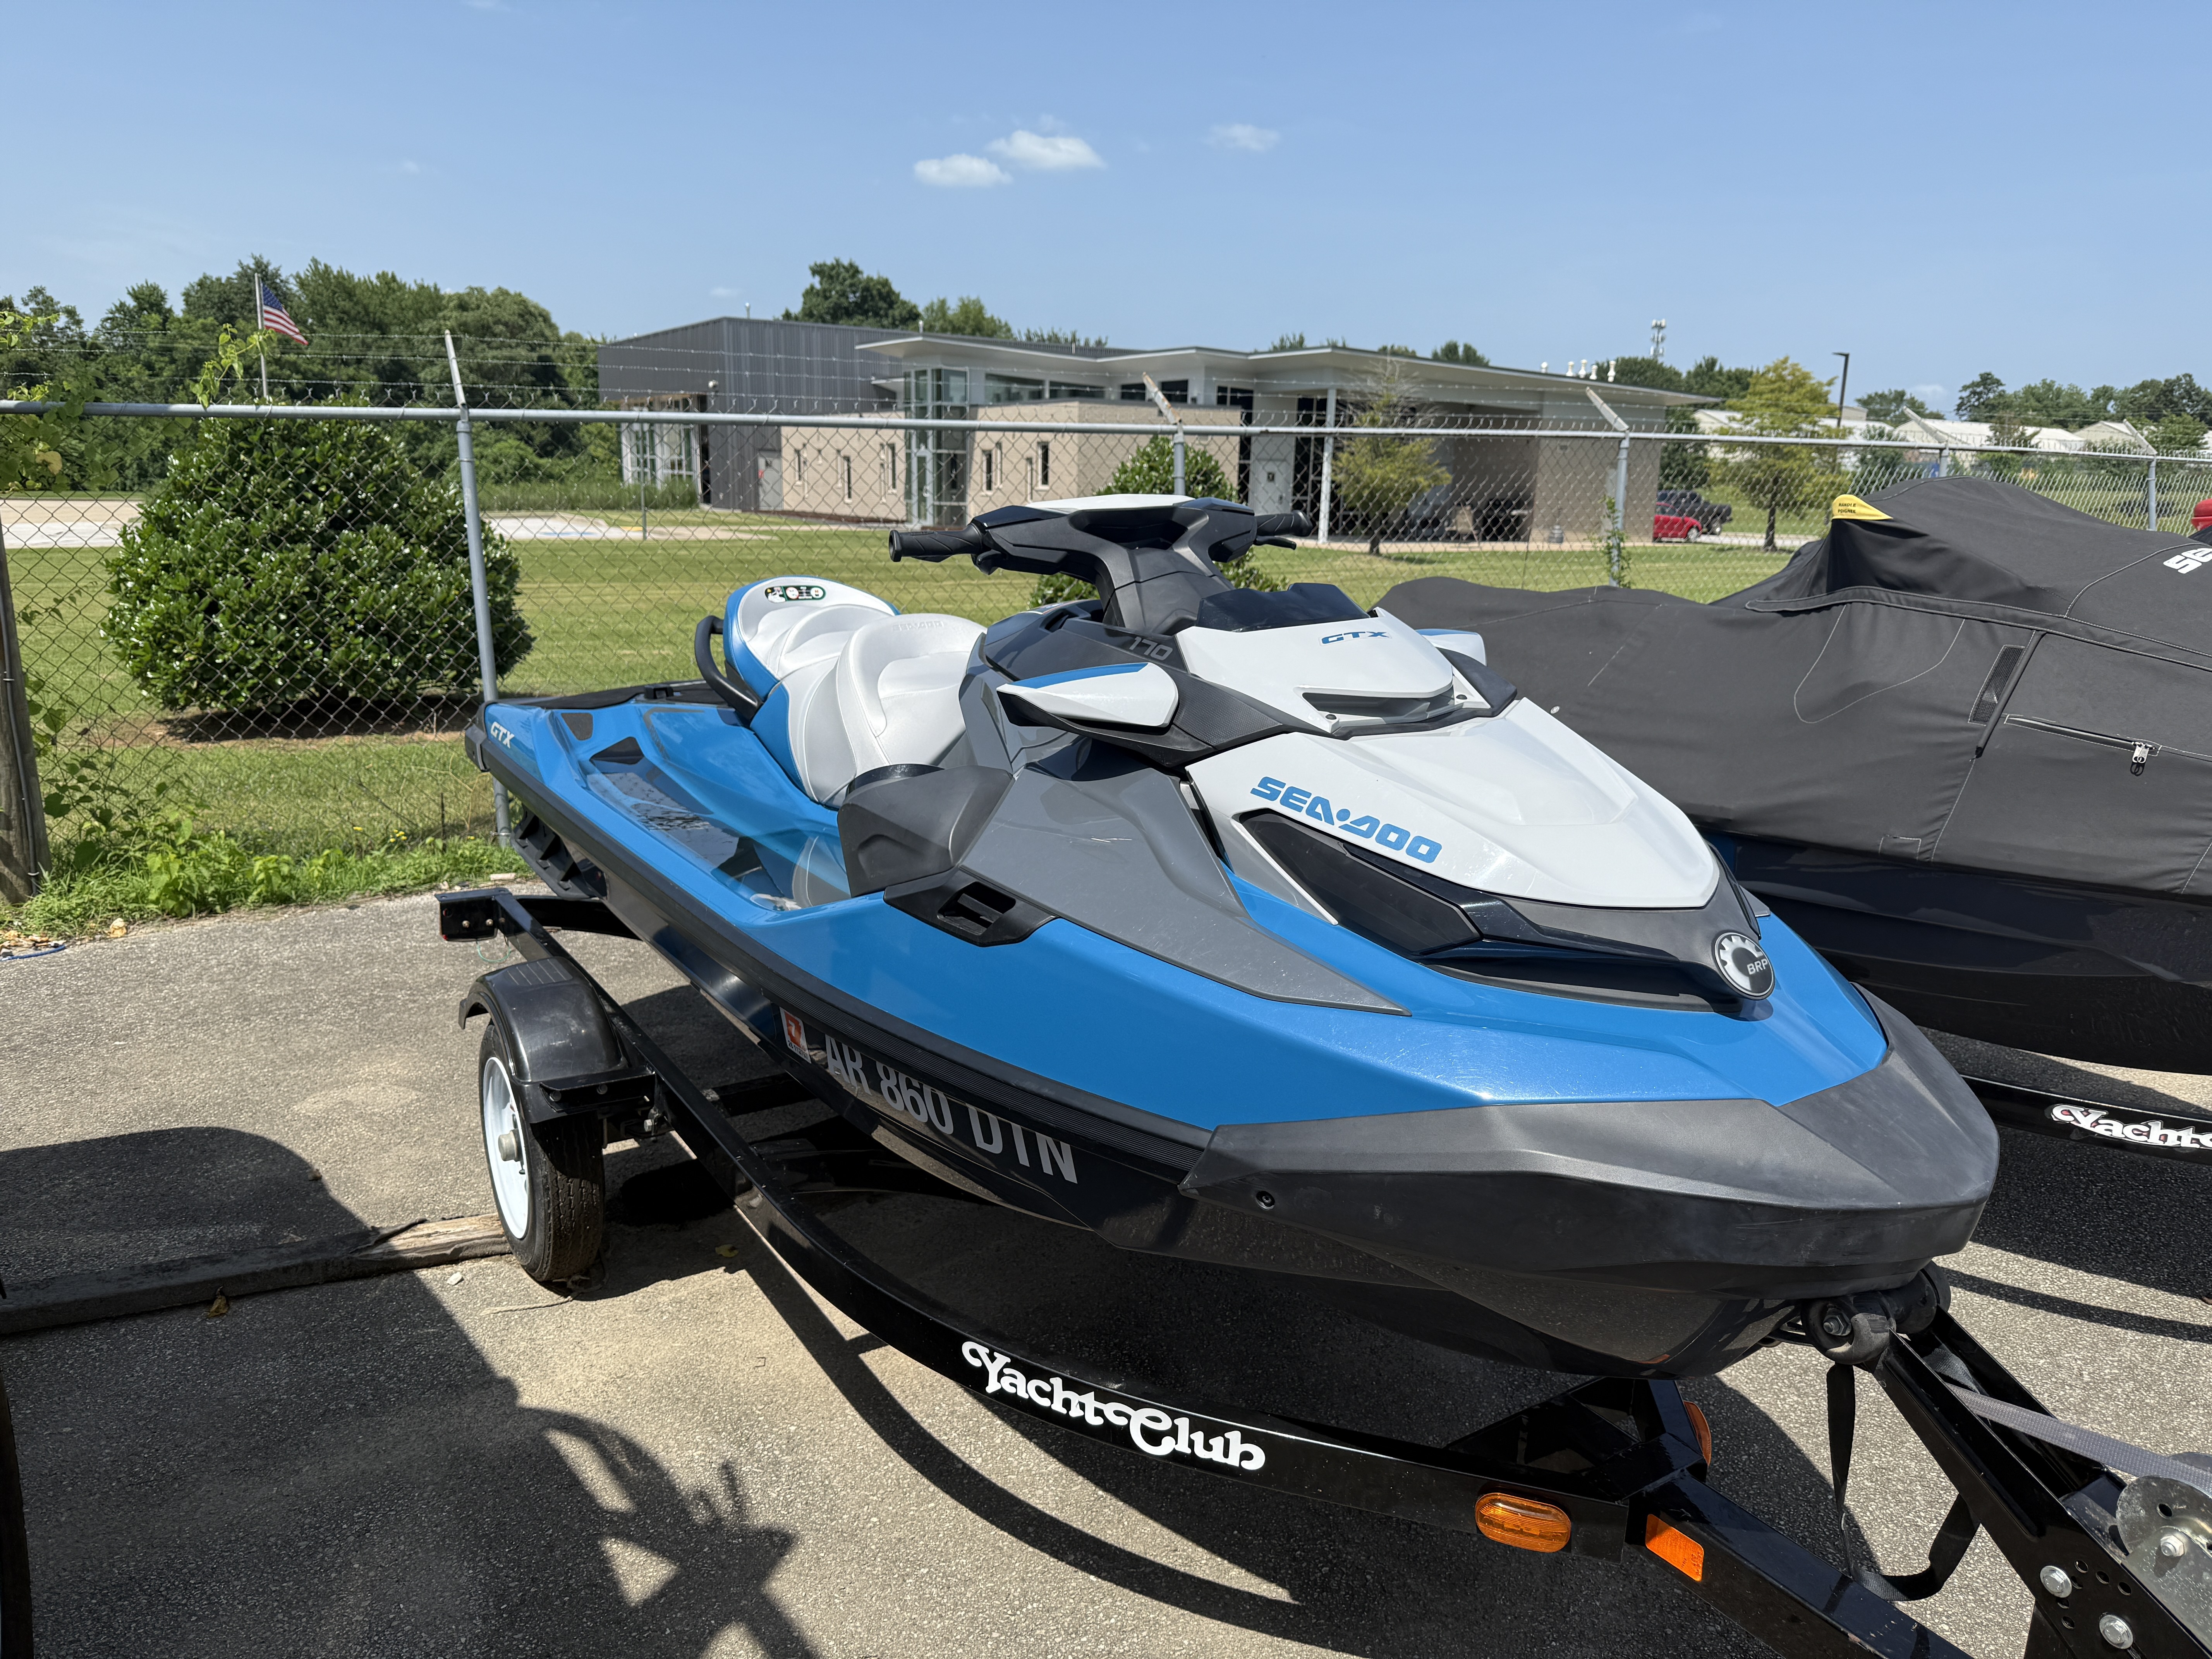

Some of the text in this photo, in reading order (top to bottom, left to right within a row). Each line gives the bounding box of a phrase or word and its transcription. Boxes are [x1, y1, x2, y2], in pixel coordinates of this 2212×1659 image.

[1129, 636, 1173, 661] 170
[1321, 631, 1389, 644] GTX
[490, 721, 515, 749] GTX
[1747, 958, 1768, 975] BRP
[825, 1034, 872, 1096] AR
[876, 1061, 954, 1134] 860
